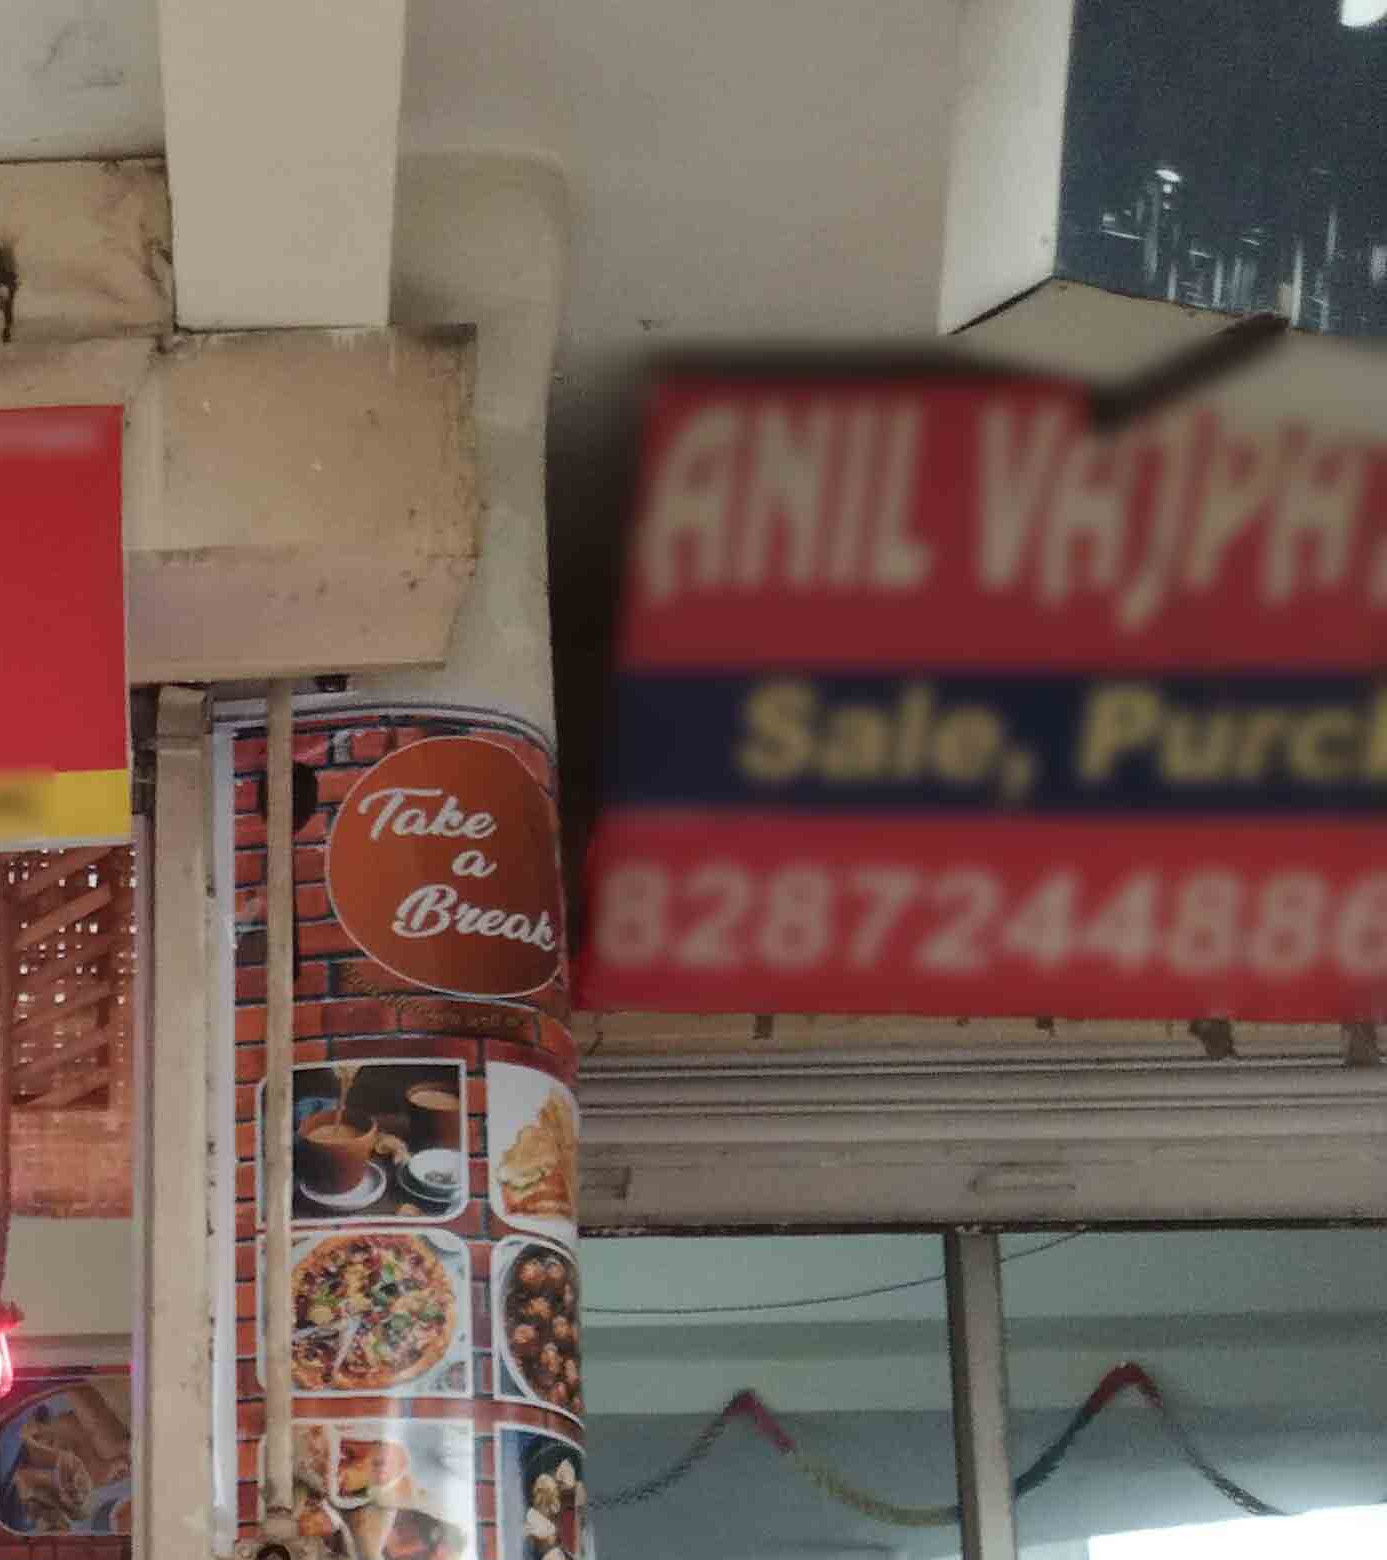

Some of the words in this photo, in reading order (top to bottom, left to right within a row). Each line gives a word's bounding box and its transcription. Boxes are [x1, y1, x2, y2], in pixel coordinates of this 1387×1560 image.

[637, 398, 933, 602] ANIL
[973, 402, 1387, 636] VAJPA
[737, 680, 1031, 800] Sale,
[358, 787, 497, 841] Take
[451, 849, 498, 878] a
[391, 884, 556, 952] Break
